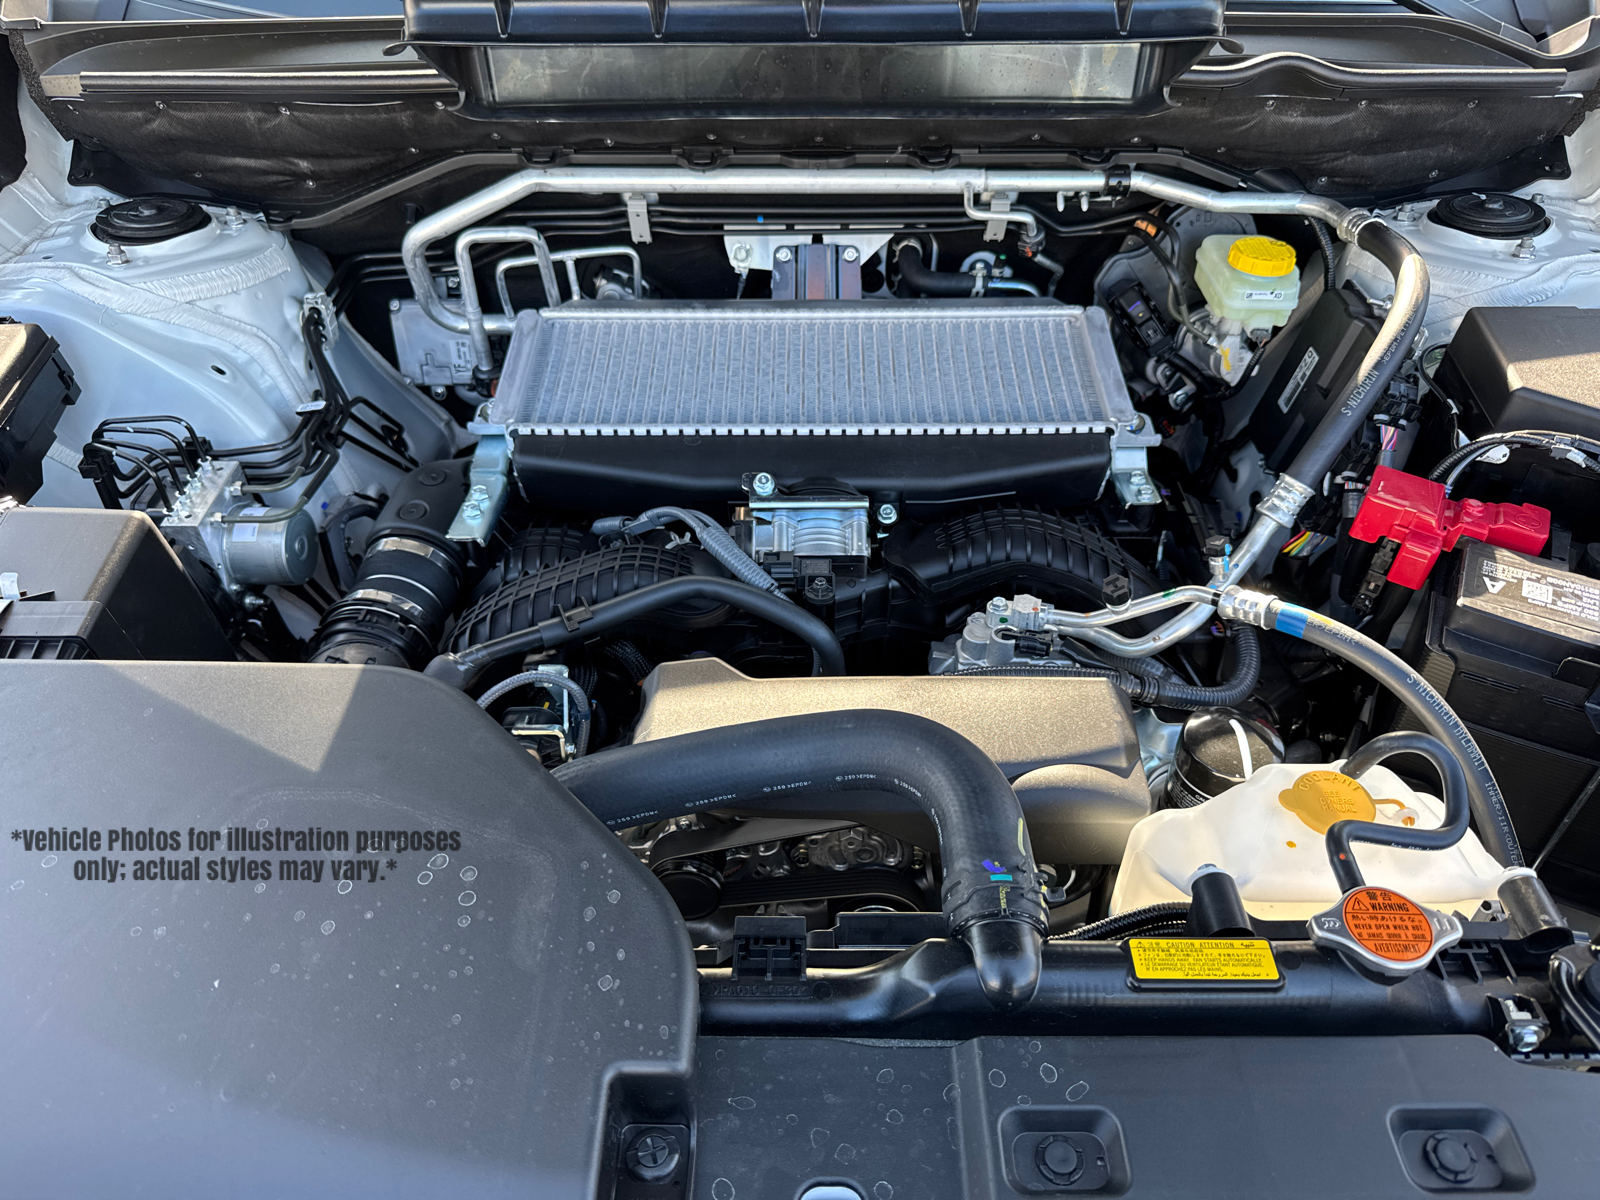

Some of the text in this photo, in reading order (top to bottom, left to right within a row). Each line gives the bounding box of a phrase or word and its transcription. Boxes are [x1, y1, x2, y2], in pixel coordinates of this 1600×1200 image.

[1298, 771, 1362, 792] COOLANT
[1322, 804, 1358, 814] MANUAL
[1366, 891, 1392, 901] 警告
[1369, 902, 1409, 912] WARNING
